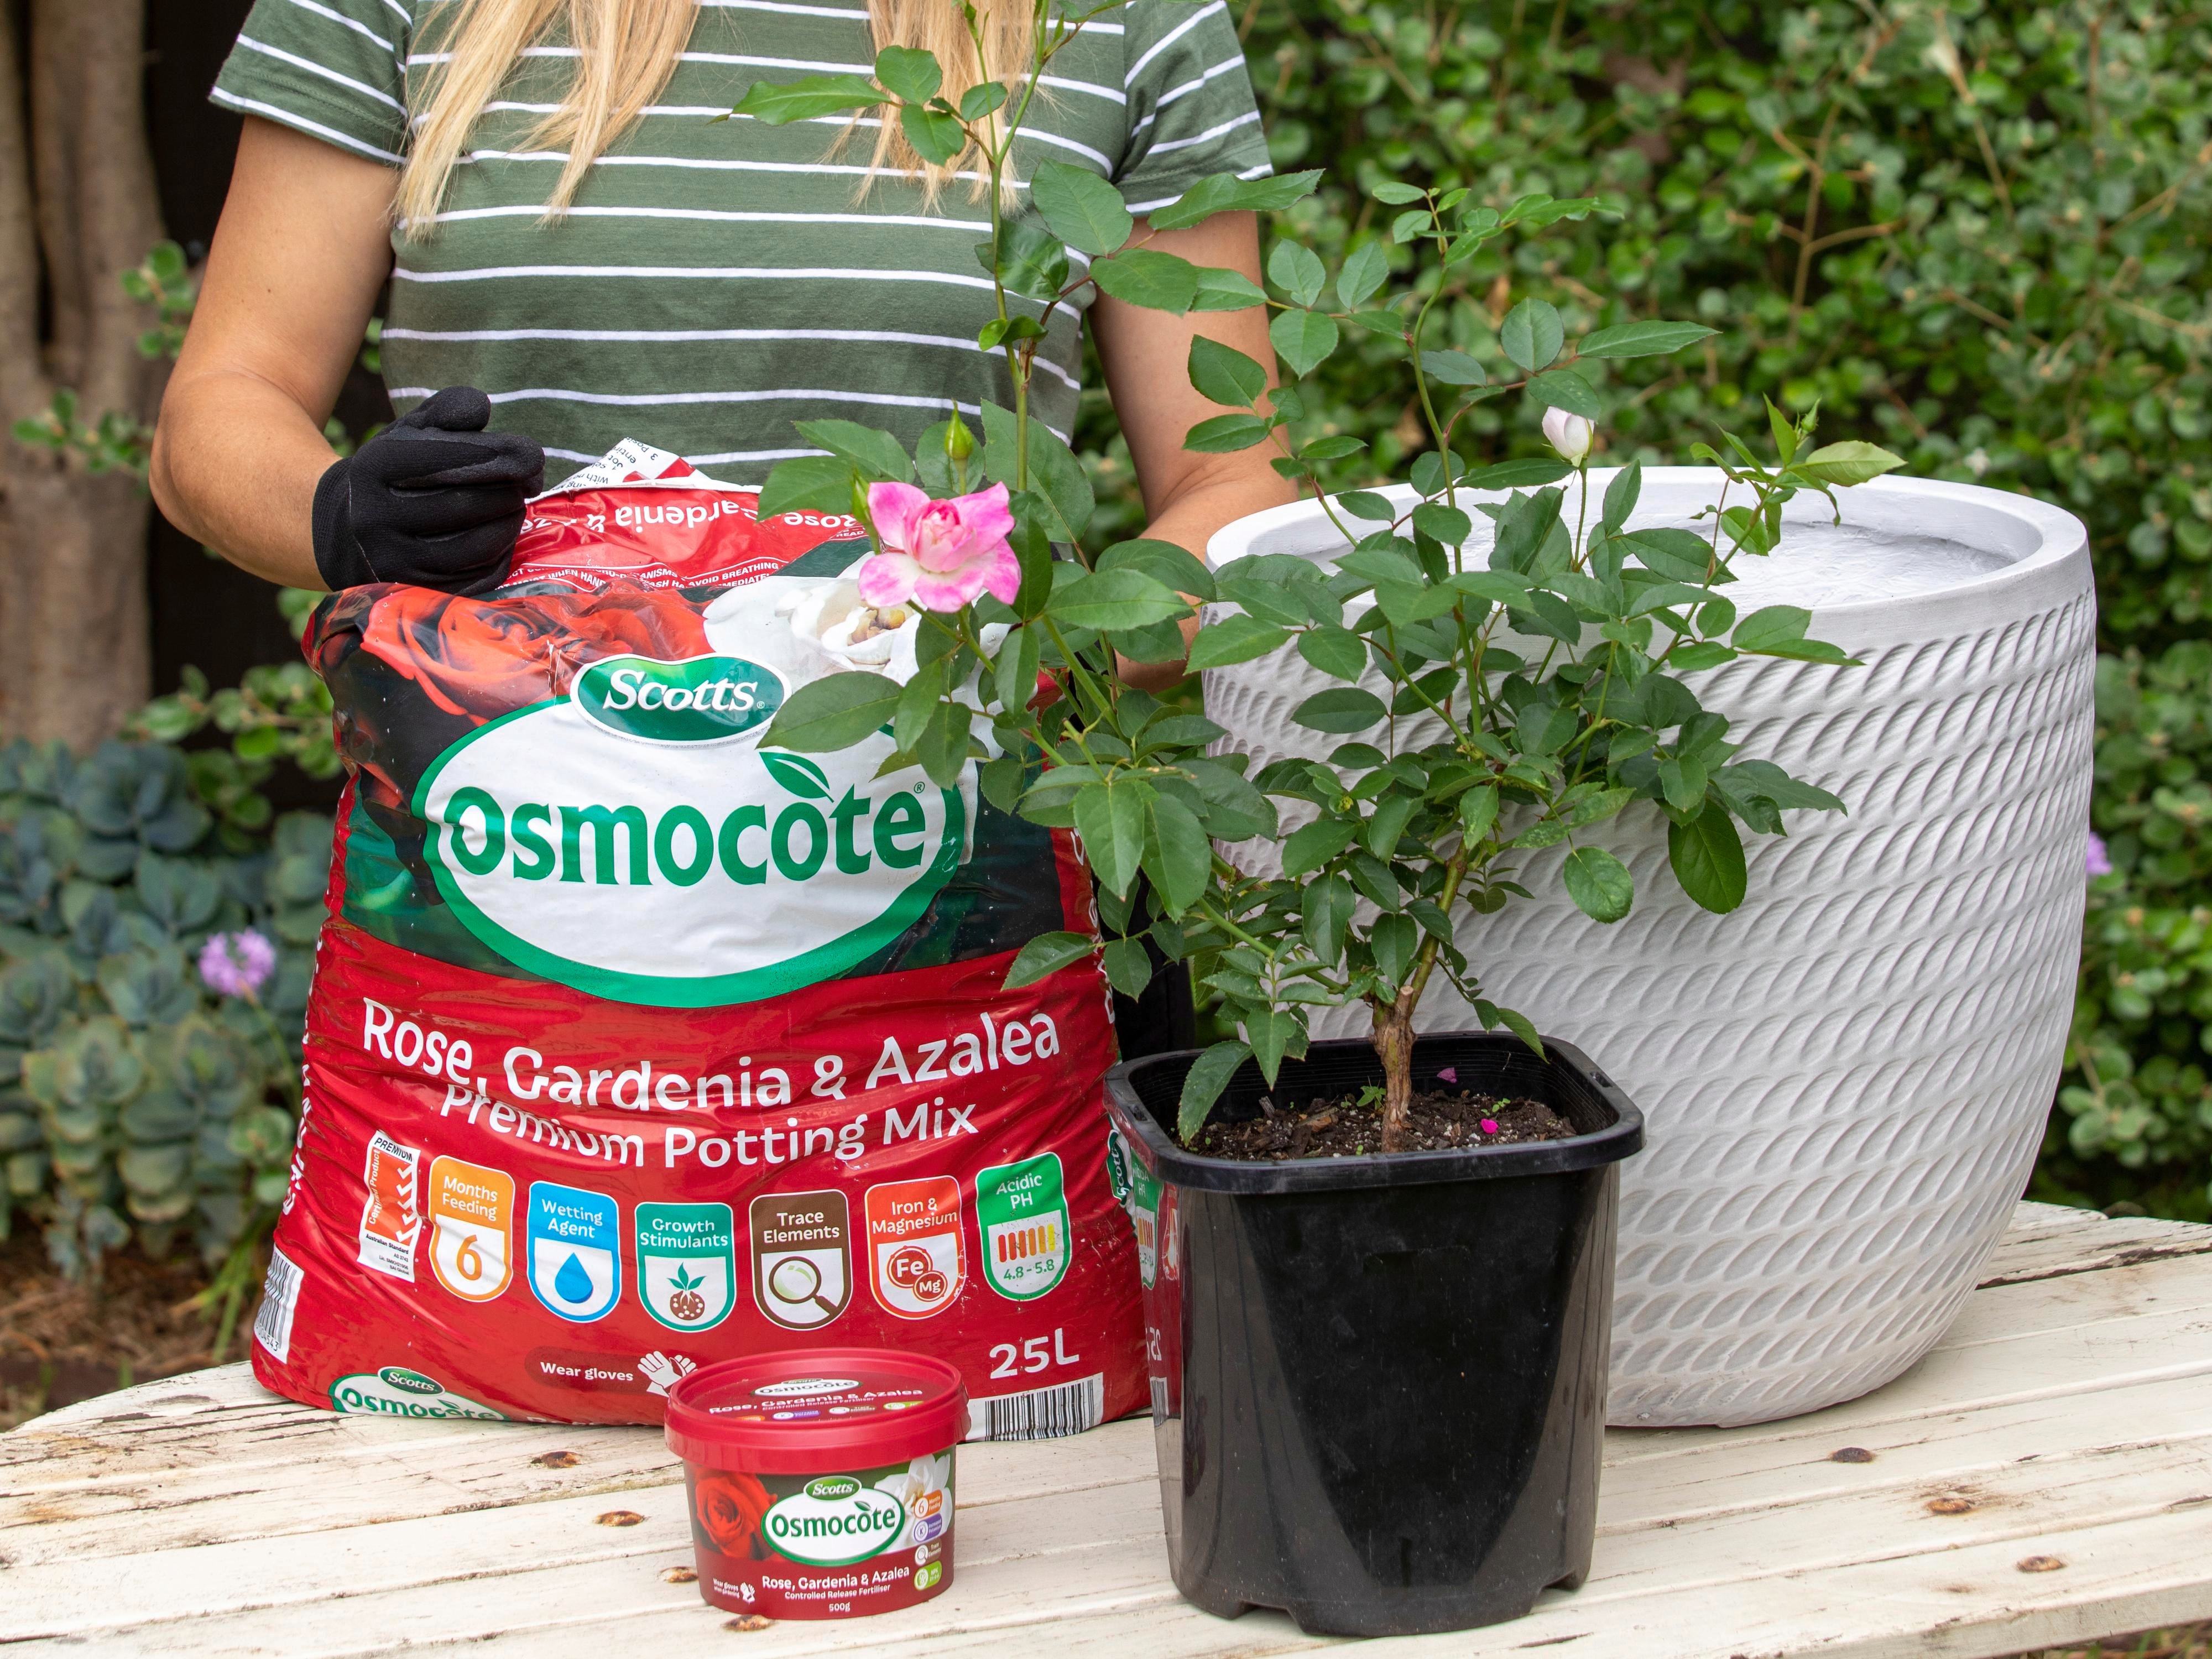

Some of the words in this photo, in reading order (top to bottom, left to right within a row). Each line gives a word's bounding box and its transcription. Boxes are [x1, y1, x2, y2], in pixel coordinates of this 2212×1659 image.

[586, 473, 608, 484] with
[688, 575, 719, 587] AVOID
[722, 562, 779, 580] BREATHING
[603, 669, 759, 712] Scotts
[363, 997, 487, 1095] Rose,
[503, 1046, 791, 1111] Gardenia
[811, 1055, 847, 1100] &
[865, 1012, 1060, 1089] Azalea
[440, 1084, 644, 1167] Premium
[665, 1114, 868, 1167] Potting
[883, 1097, 979, 1145] Mix
[374, 1138, 413, 1162] PREMIUM
[369, 1149, 380, 1187] Product
[444, 1176, 498, 1202] Months
[996, 1173, 1042, 1195] Acidic
[442, 1193, 497, 1222] Feeding
[891, 1199, 924, 1215] Iron
[927, 1197, 938, 1211] &
[1010, 1192, 1033, 1209] PH
[541, 1198, 603, 1226] Wetting
[776, 1211, 824, 1227] Trace
[547, 1218, 596, 1239] Agent
[652, 1218, 715, 1233] Growth
[872, 1211, 958, 1235] Magnesium
[366, 1234, 388, 1246] Australian
[388, 1243, 409, 1254] Standard
[640, 1232, 728, 1249] Stimulants
[763, 1225, 840, 1244] Elements
[456, 1234, 482, 1281] 6
[896, 1258, 924, 1278] Fe
[919, 1279, 941, 1294] Mg
[989, 1328, 1079, 1379] 25L
[388, 1371, 435, 1391] Scotts
[540, 1361, 581, 1376] Wear
[585, 1368, 633, 1381] gloves
[761, 1395, 843, 1407] Gardenia
[864, 1390, 922, 1398] Azalea
[812, 1483, 854, 1496] Scotts
[919, 1500, 924, 1514] 6
[771, 1506, 895, 1538] Osmocote
[762, 1576, 796, 1591] Rose,
[798, 1572, 858, 1589] Gardenia
[861, 1573, 869, 1585] &
[872, 1566, 910, 1584] Azalea
[785, 1590, 826, 1600] Controlled
[827, 1589, 857, 1599] Release
[858, 1584, 891, 1596] Fertiliser
[829, 1602, 851, 1613] 500g
